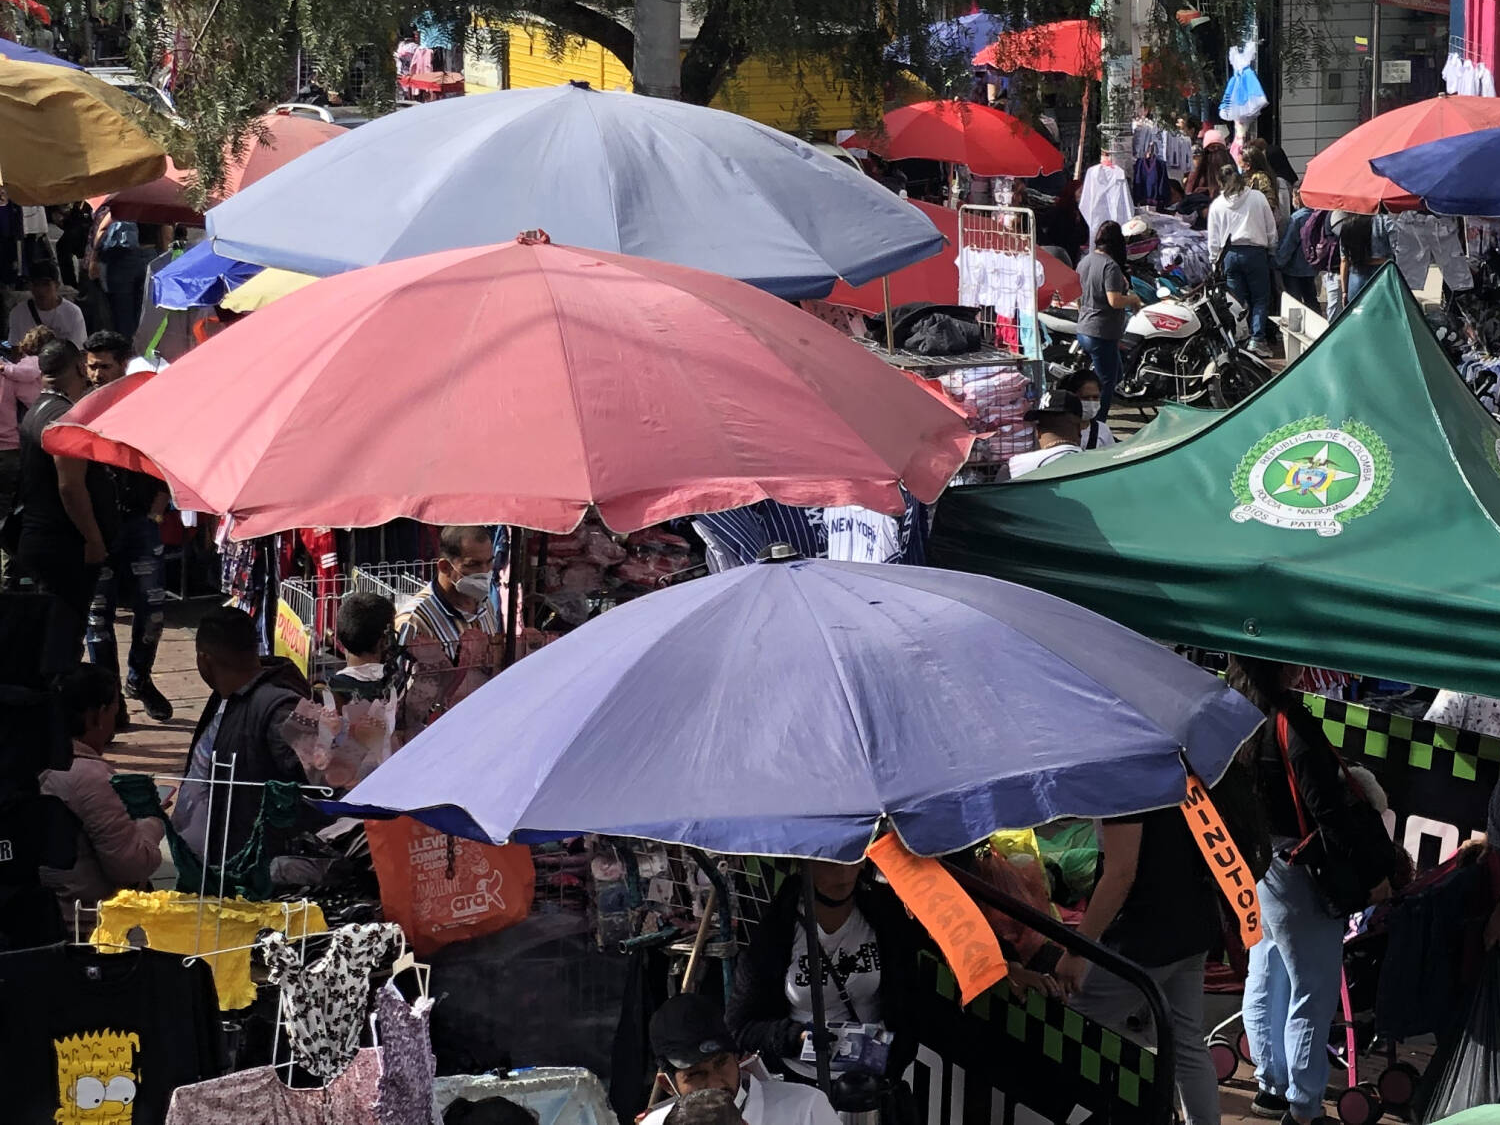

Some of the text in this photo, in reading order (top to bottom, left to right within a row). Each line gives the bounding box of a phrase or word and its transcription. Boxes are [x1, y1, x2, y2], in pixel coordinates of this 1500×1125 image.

[1324, 432, 1341, 442] DE
[831, 517, 853, 535] NEW
[1243, 505, 1270, 522] DIOS
[1290, 520, 1337, 529] PATRIA
[410, 844, 463, 865] COMPRS
[1184, 785, 1258, 933] MINUTOS
[452, 893, 487, 912] ara
